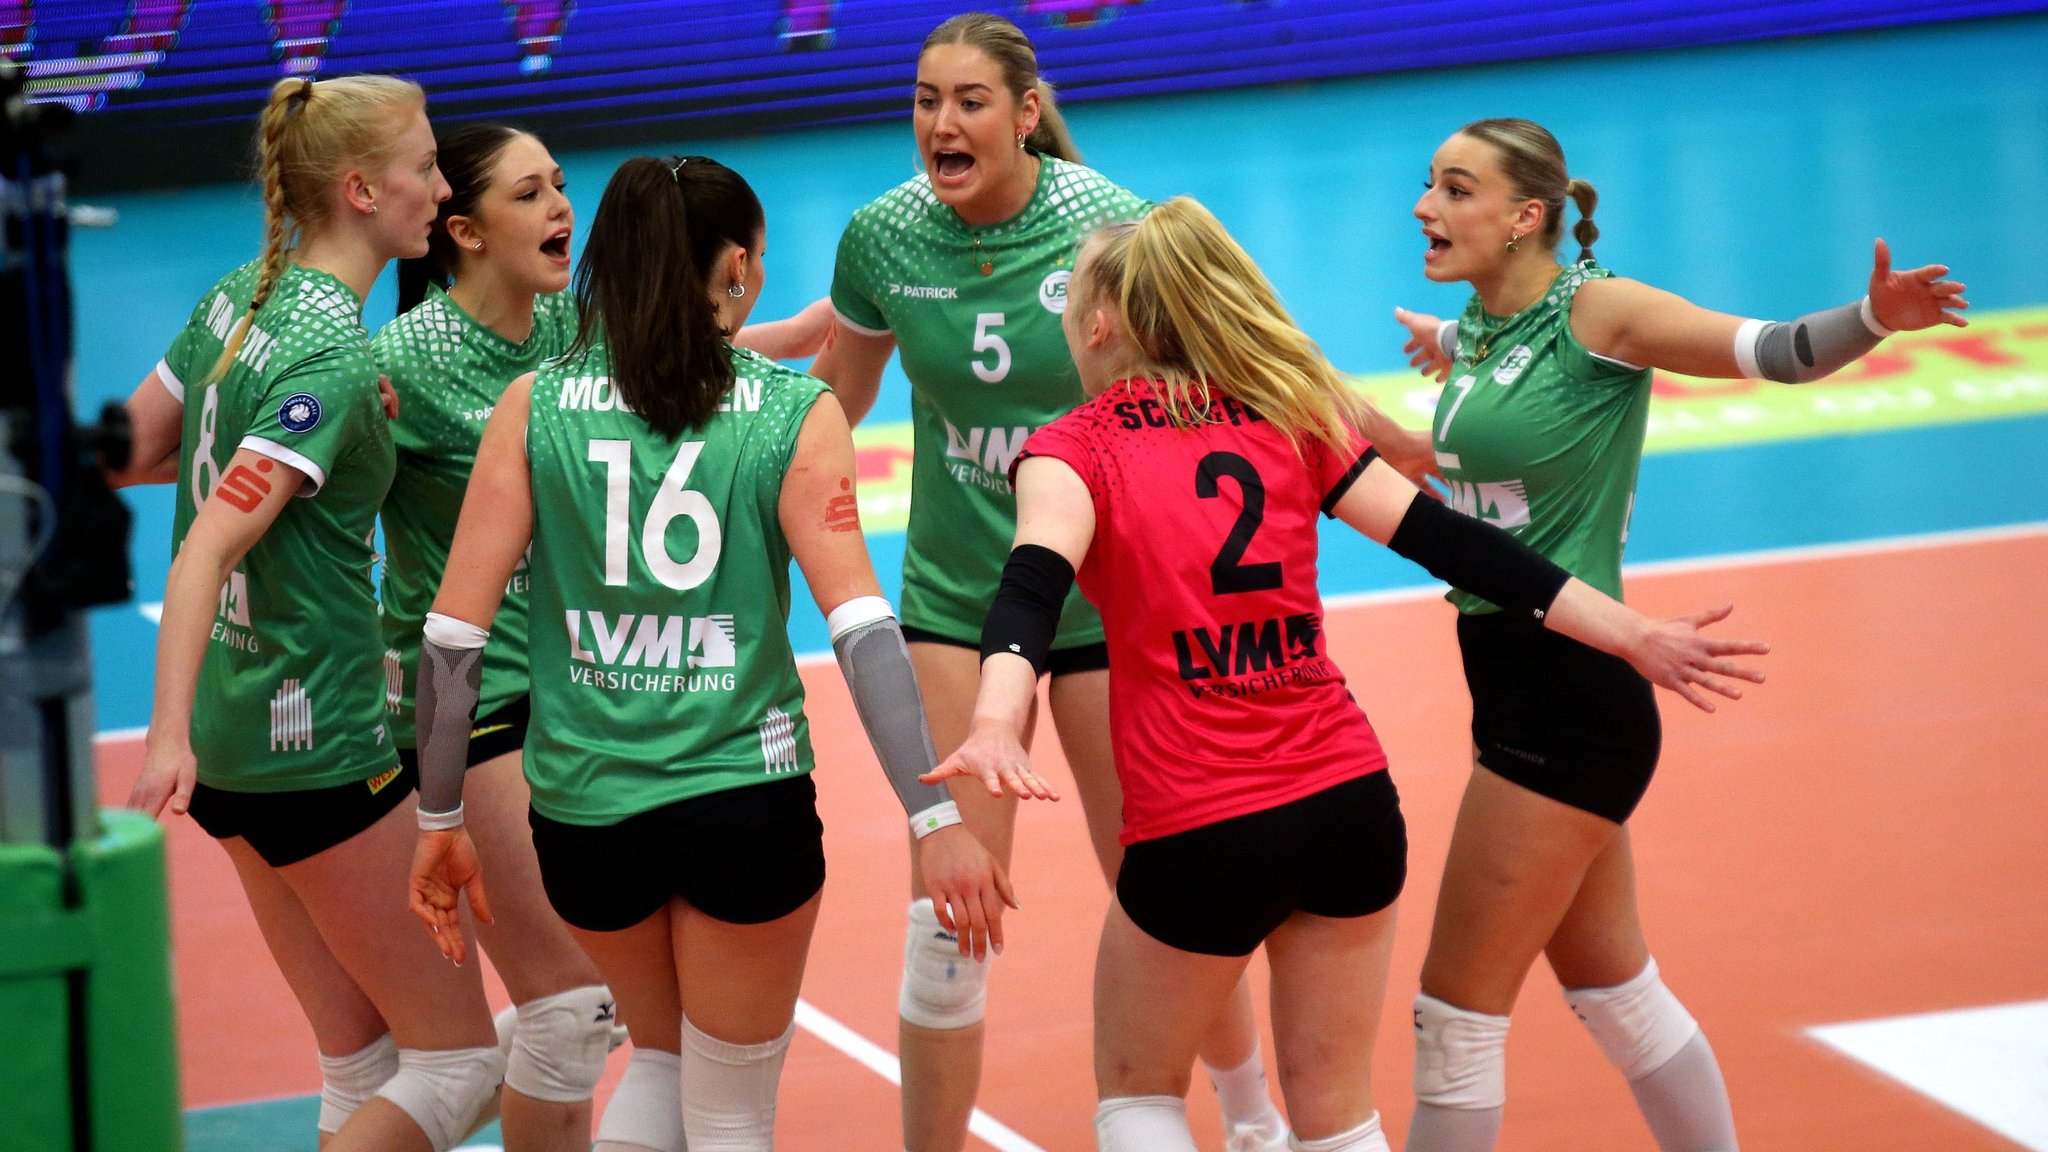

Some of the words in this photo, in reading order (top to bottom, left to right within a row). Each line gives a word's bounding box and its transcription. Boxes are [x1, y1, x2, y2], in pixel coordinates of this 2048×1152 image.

[904, 285, 958, 299] PATRICK
[971, 313, 1012, 383] 5
[191, 382, 220, 515] 8
[588, 439, 722, 591] 16
[1195, 451, 1284, 595] 2
[565, 609, 683, 668] LVM
[1172, 618, 1287, 681] LVM
[569, 665, 736, 693] VERSICHERUNG
[1188, 660, 1330, 699] VERSICHERUNG
